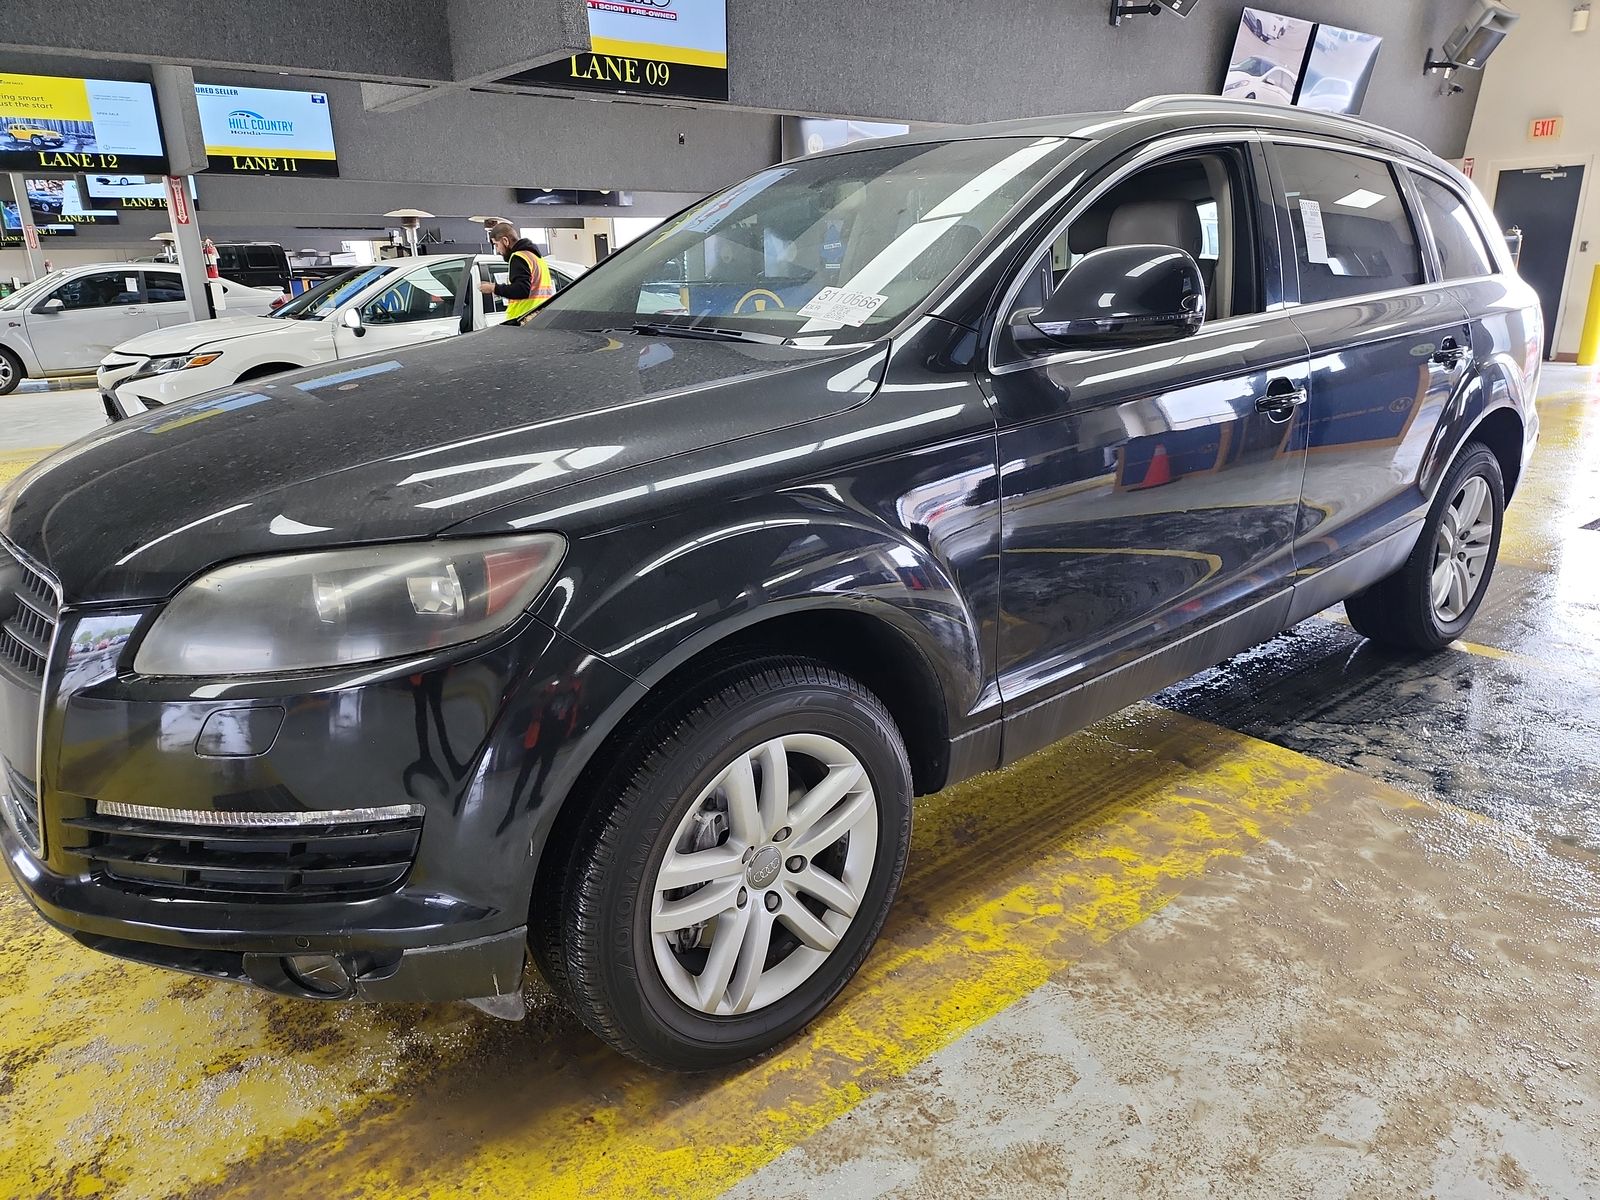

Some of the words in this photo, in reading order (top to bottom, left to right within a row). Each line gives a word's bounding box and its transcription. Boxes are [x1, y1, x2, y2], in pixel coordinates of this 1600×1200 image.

[599, 3, 625, 13] SCION
[630, 8, 676, 20] PRE-OWNED
[570, 54, 641, 84] LANE
[645, 61, 670, 87] 09
[1, 93, 15, 101] ing
[17, 94, 45, 102] smart
[195, 87, 214, 95] URED
[215, 88, 239, 96] SELLER
[228, 118, 251, 130] HILL
[251, 119, 294, 132] COUNTRY
[1533, 120, 1556, 137] EXIT
[38, 152, 95, 168] LANE
[99, 154, 118, 168] 12
[232, 156, 279, 171] LANE
[282, 158, 298, 172] 11
[122, 197, 156, 208] LANE
[86, 215, 96, 223] 14
[818, 289, 881, 309] 3110666
